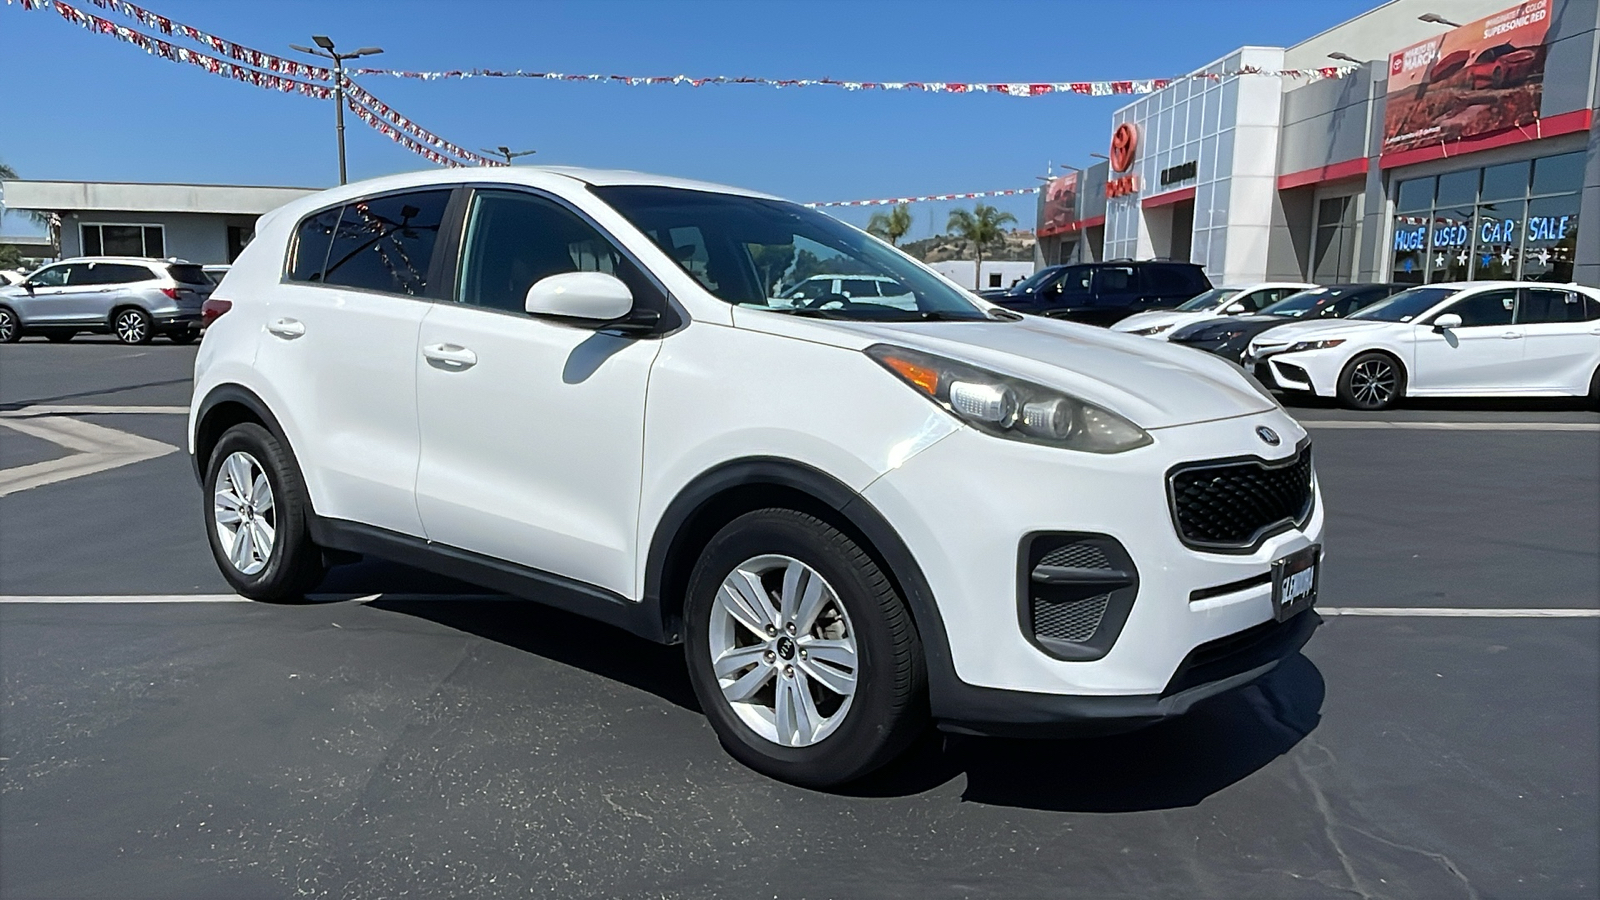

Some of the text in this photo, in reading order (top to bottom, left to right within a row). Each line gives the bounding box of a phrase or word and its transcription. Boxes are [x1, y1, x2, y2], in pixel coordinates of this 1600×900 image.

[1483, 15, 1530, 39] SUPERSONIC
[1530, 9, 1546, 23] RED
[1394, 215, 1569, 250] HUGE USED CAR SALE
